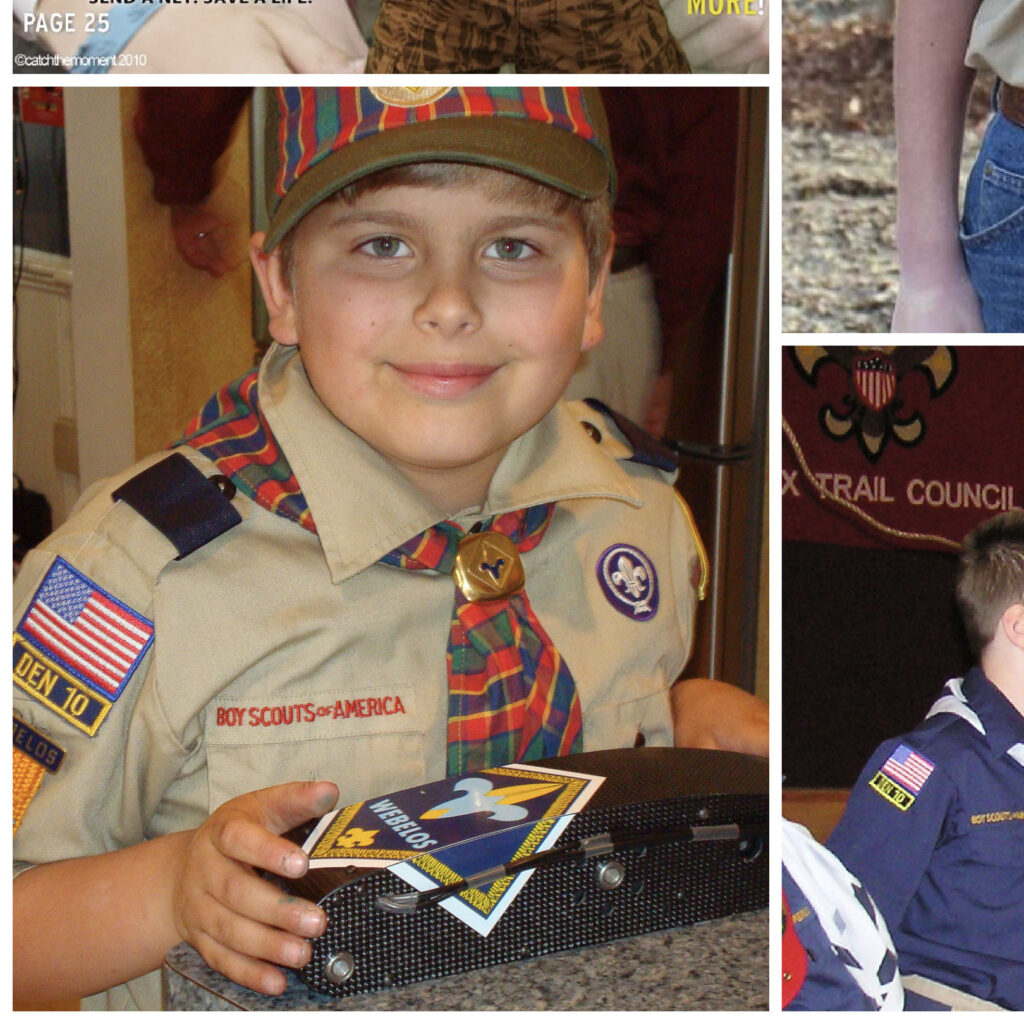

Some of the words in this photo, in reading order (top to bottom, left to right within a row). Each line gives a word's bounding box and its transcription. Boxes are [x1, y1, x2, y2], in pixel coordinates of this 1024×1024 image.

[23, 13, 76, 33] PAGE
[85, 13, 110, 33] 25
[815, 472, 895, 502] TRAIL
[906, 478, 1022, 511] COUNCIL
[14, 652, 59, 697] DEN
[62, 686, 90, 716] 10
[216, 706, 246, 727] BOY
[247, 702, 316, 727] SCOUTS
[332, 696, 406, 720] AMERICA
[368, 798, 441, 851] WEBELOS
